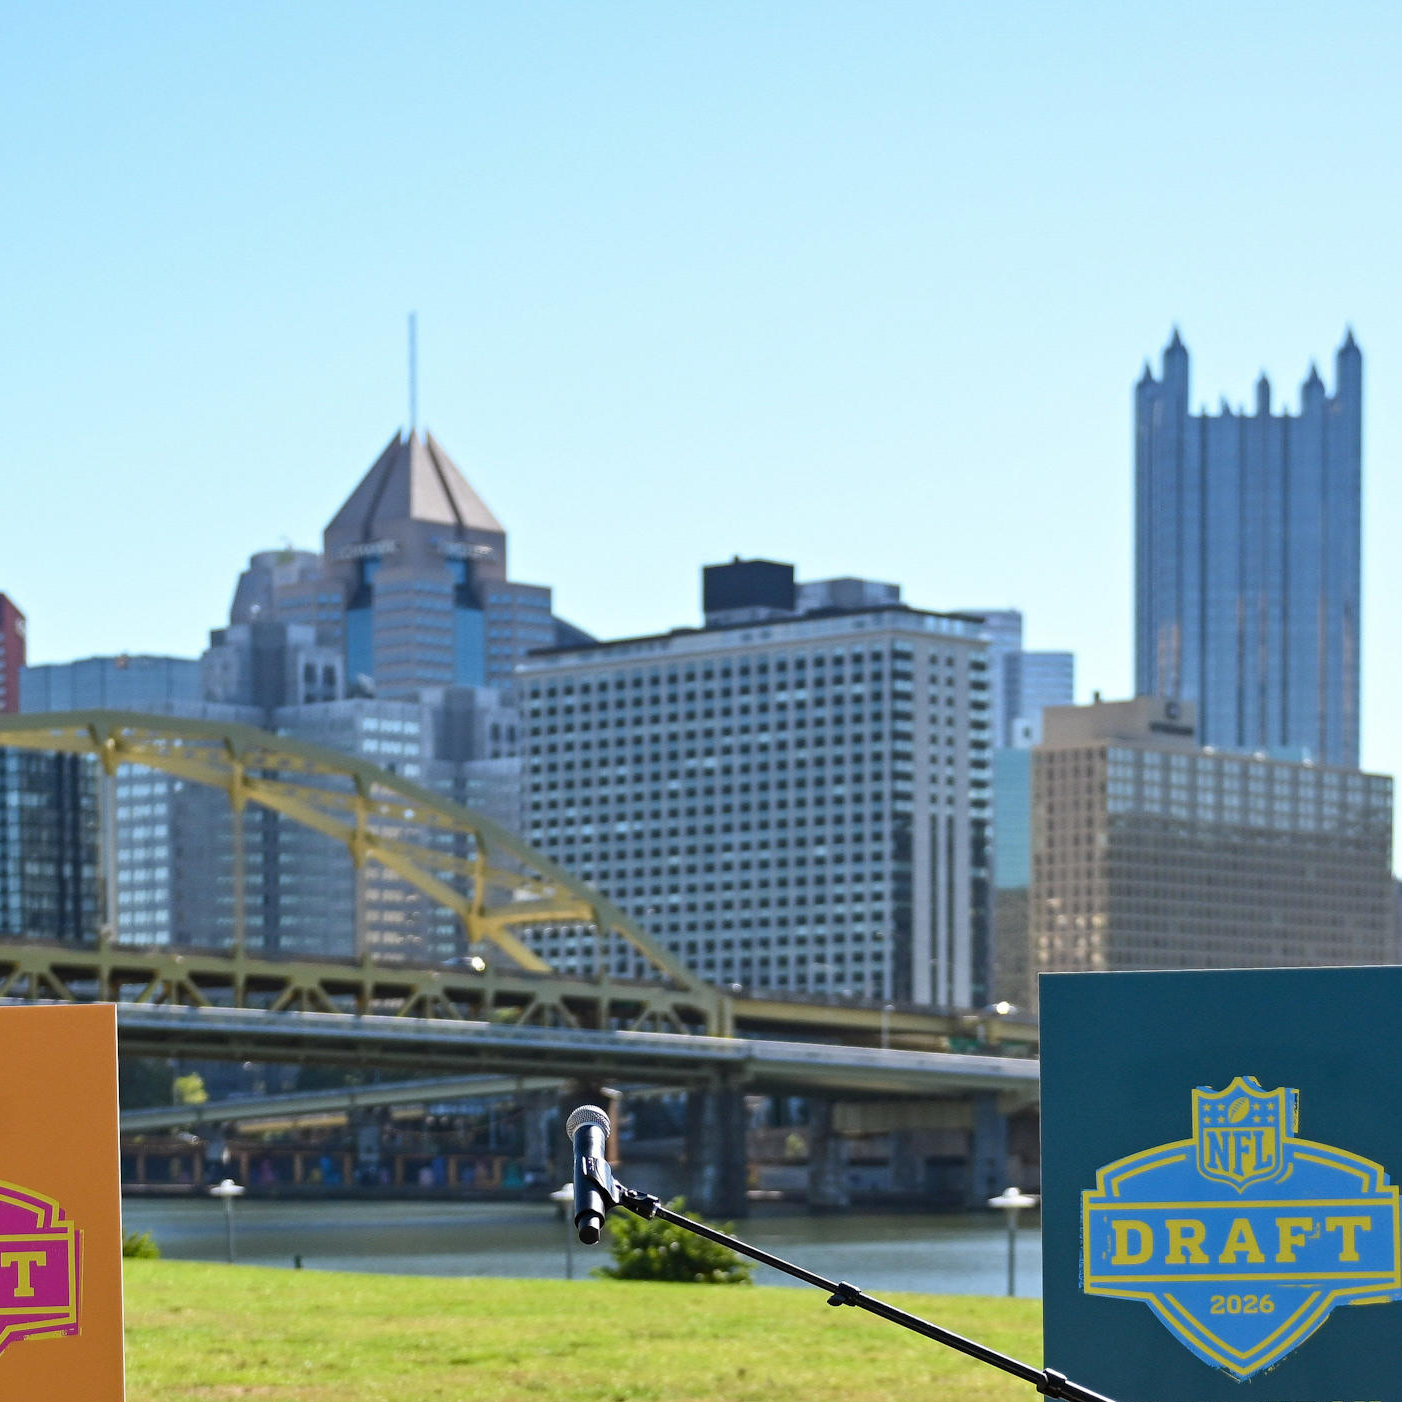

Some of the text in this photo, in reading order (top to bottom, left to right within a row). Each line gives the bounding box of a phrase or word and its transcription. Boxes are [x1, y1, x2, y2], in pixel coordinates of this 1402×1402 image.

[1207, 1130, 1273, 1176] NFL
[1111, 1216, 1372, 1266] DRAFT
[1210, 1294, 1275, 1315] 2026
